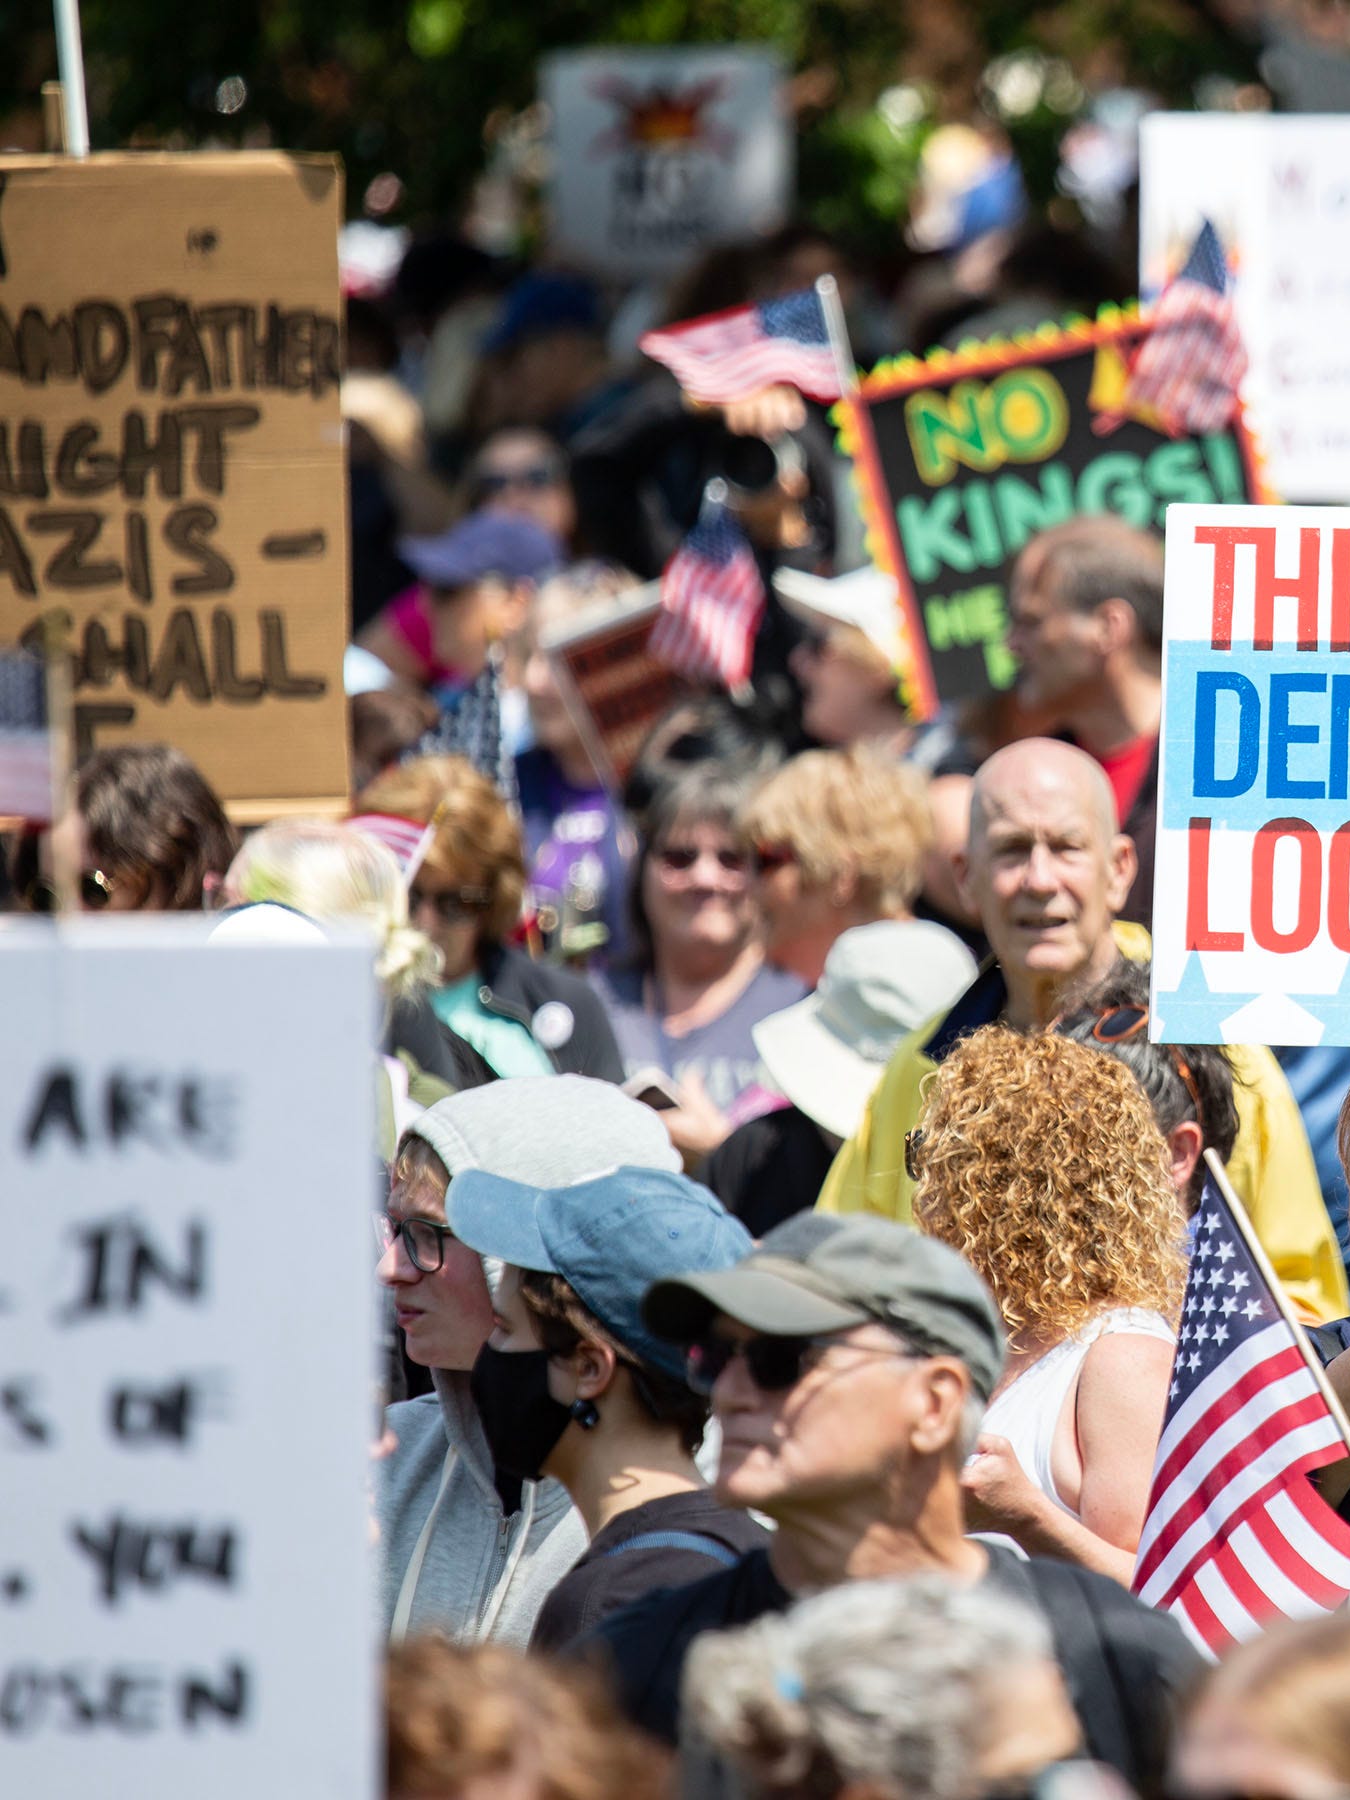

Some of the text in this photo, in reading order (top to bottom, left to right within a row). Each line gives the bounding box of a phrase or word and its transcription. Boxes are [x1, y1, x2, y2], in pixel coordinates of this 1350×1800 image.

[905, 366, 1068, 487] NO
[895, 430, 1243, 582] KINGS!
[20, 1060, 242, 1162] ARE
[54, 1208, 212, 1328] IN
[69, 1508, 238, 1605] YOU
